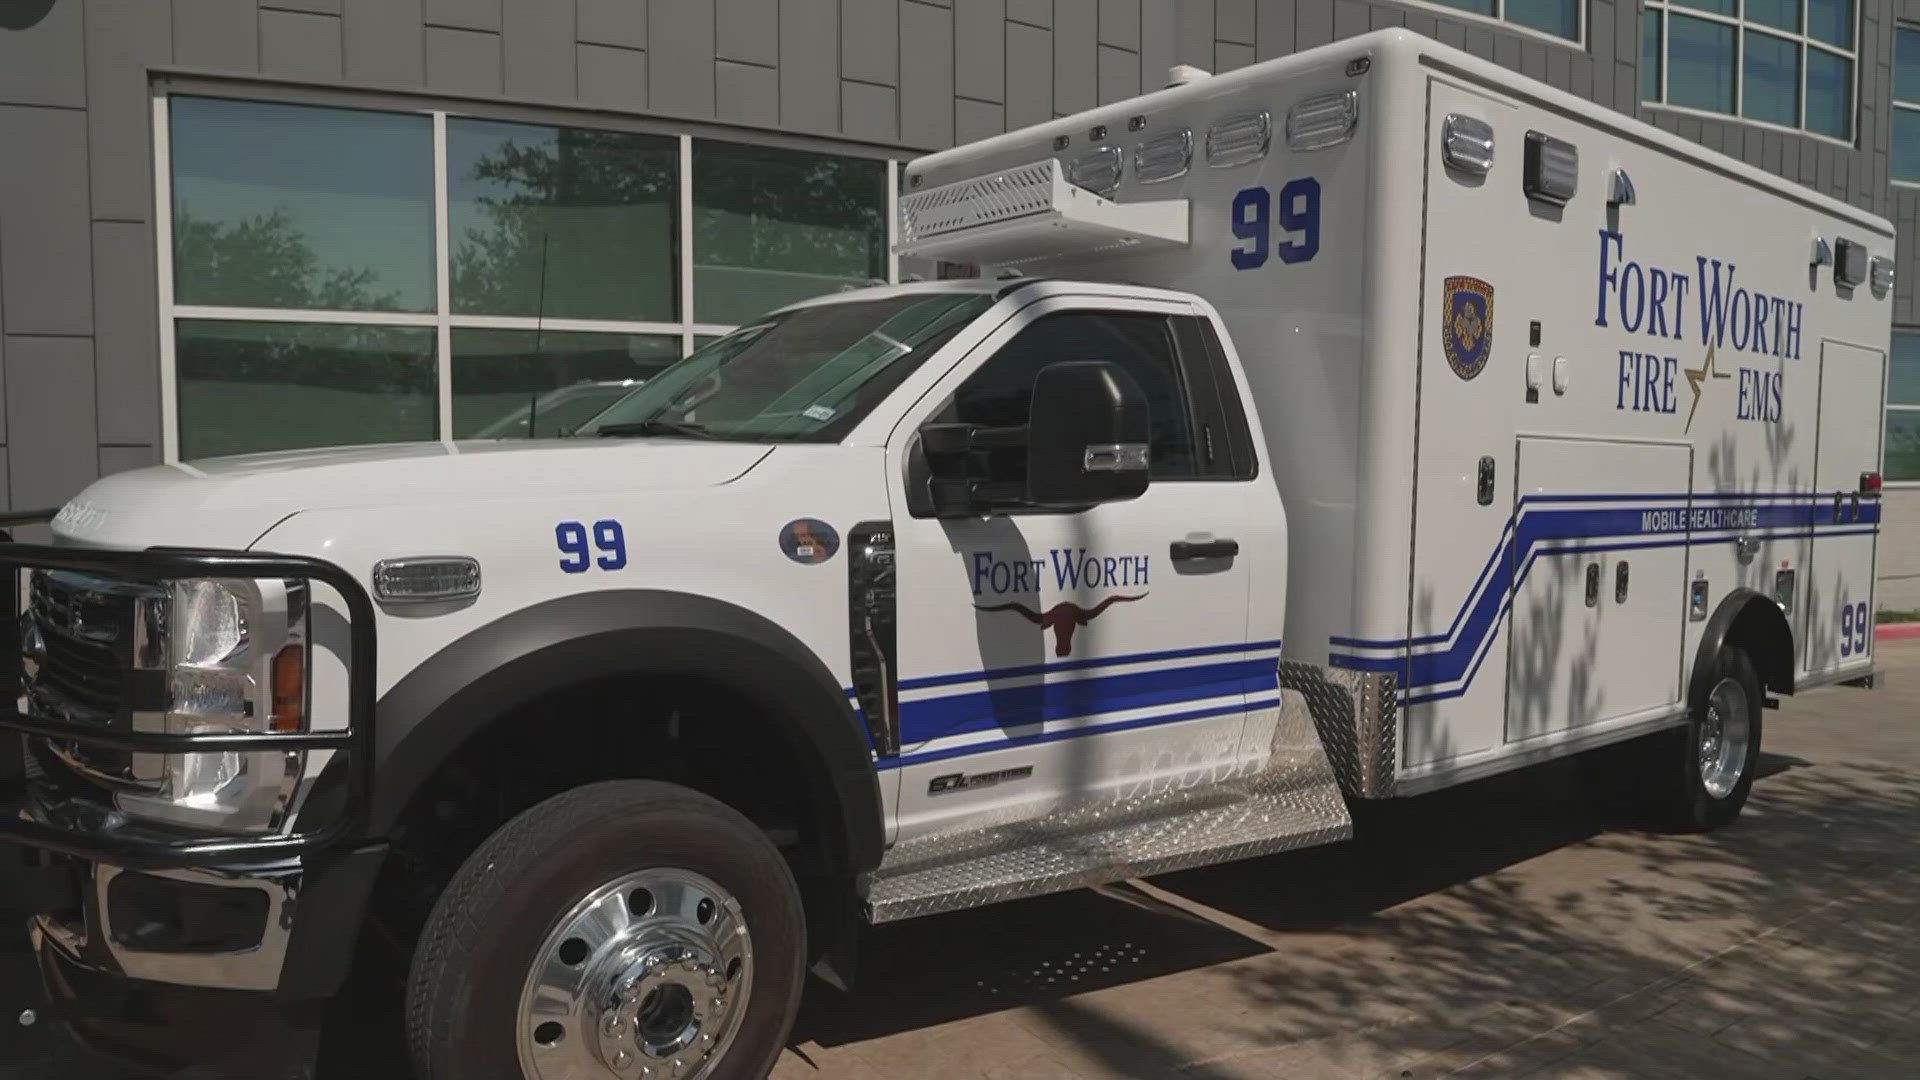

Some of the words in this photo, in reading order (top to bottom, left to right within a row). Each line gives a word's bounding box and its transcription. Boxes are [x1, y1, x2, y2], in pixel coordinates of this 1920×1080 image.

[1231, 176, 1321, 271] 99
[1595, 229, 1689, 340] FORT
[1696, 255, 1803, 360] WORTH
[1616, 350, 1678, 414] FIRE
[1736, 367, 1783, 423] EMS
[555, 519, 627, 574] 99
[1642, 510, 1687, 532] MOBILE
[1689, 509, 1758, 529] HEALTHCARE
[973, 551, 1045, 596] FORT
[1050, 548, 1149, 591] WORTH
[1840, 601, 1867, 658] 99
